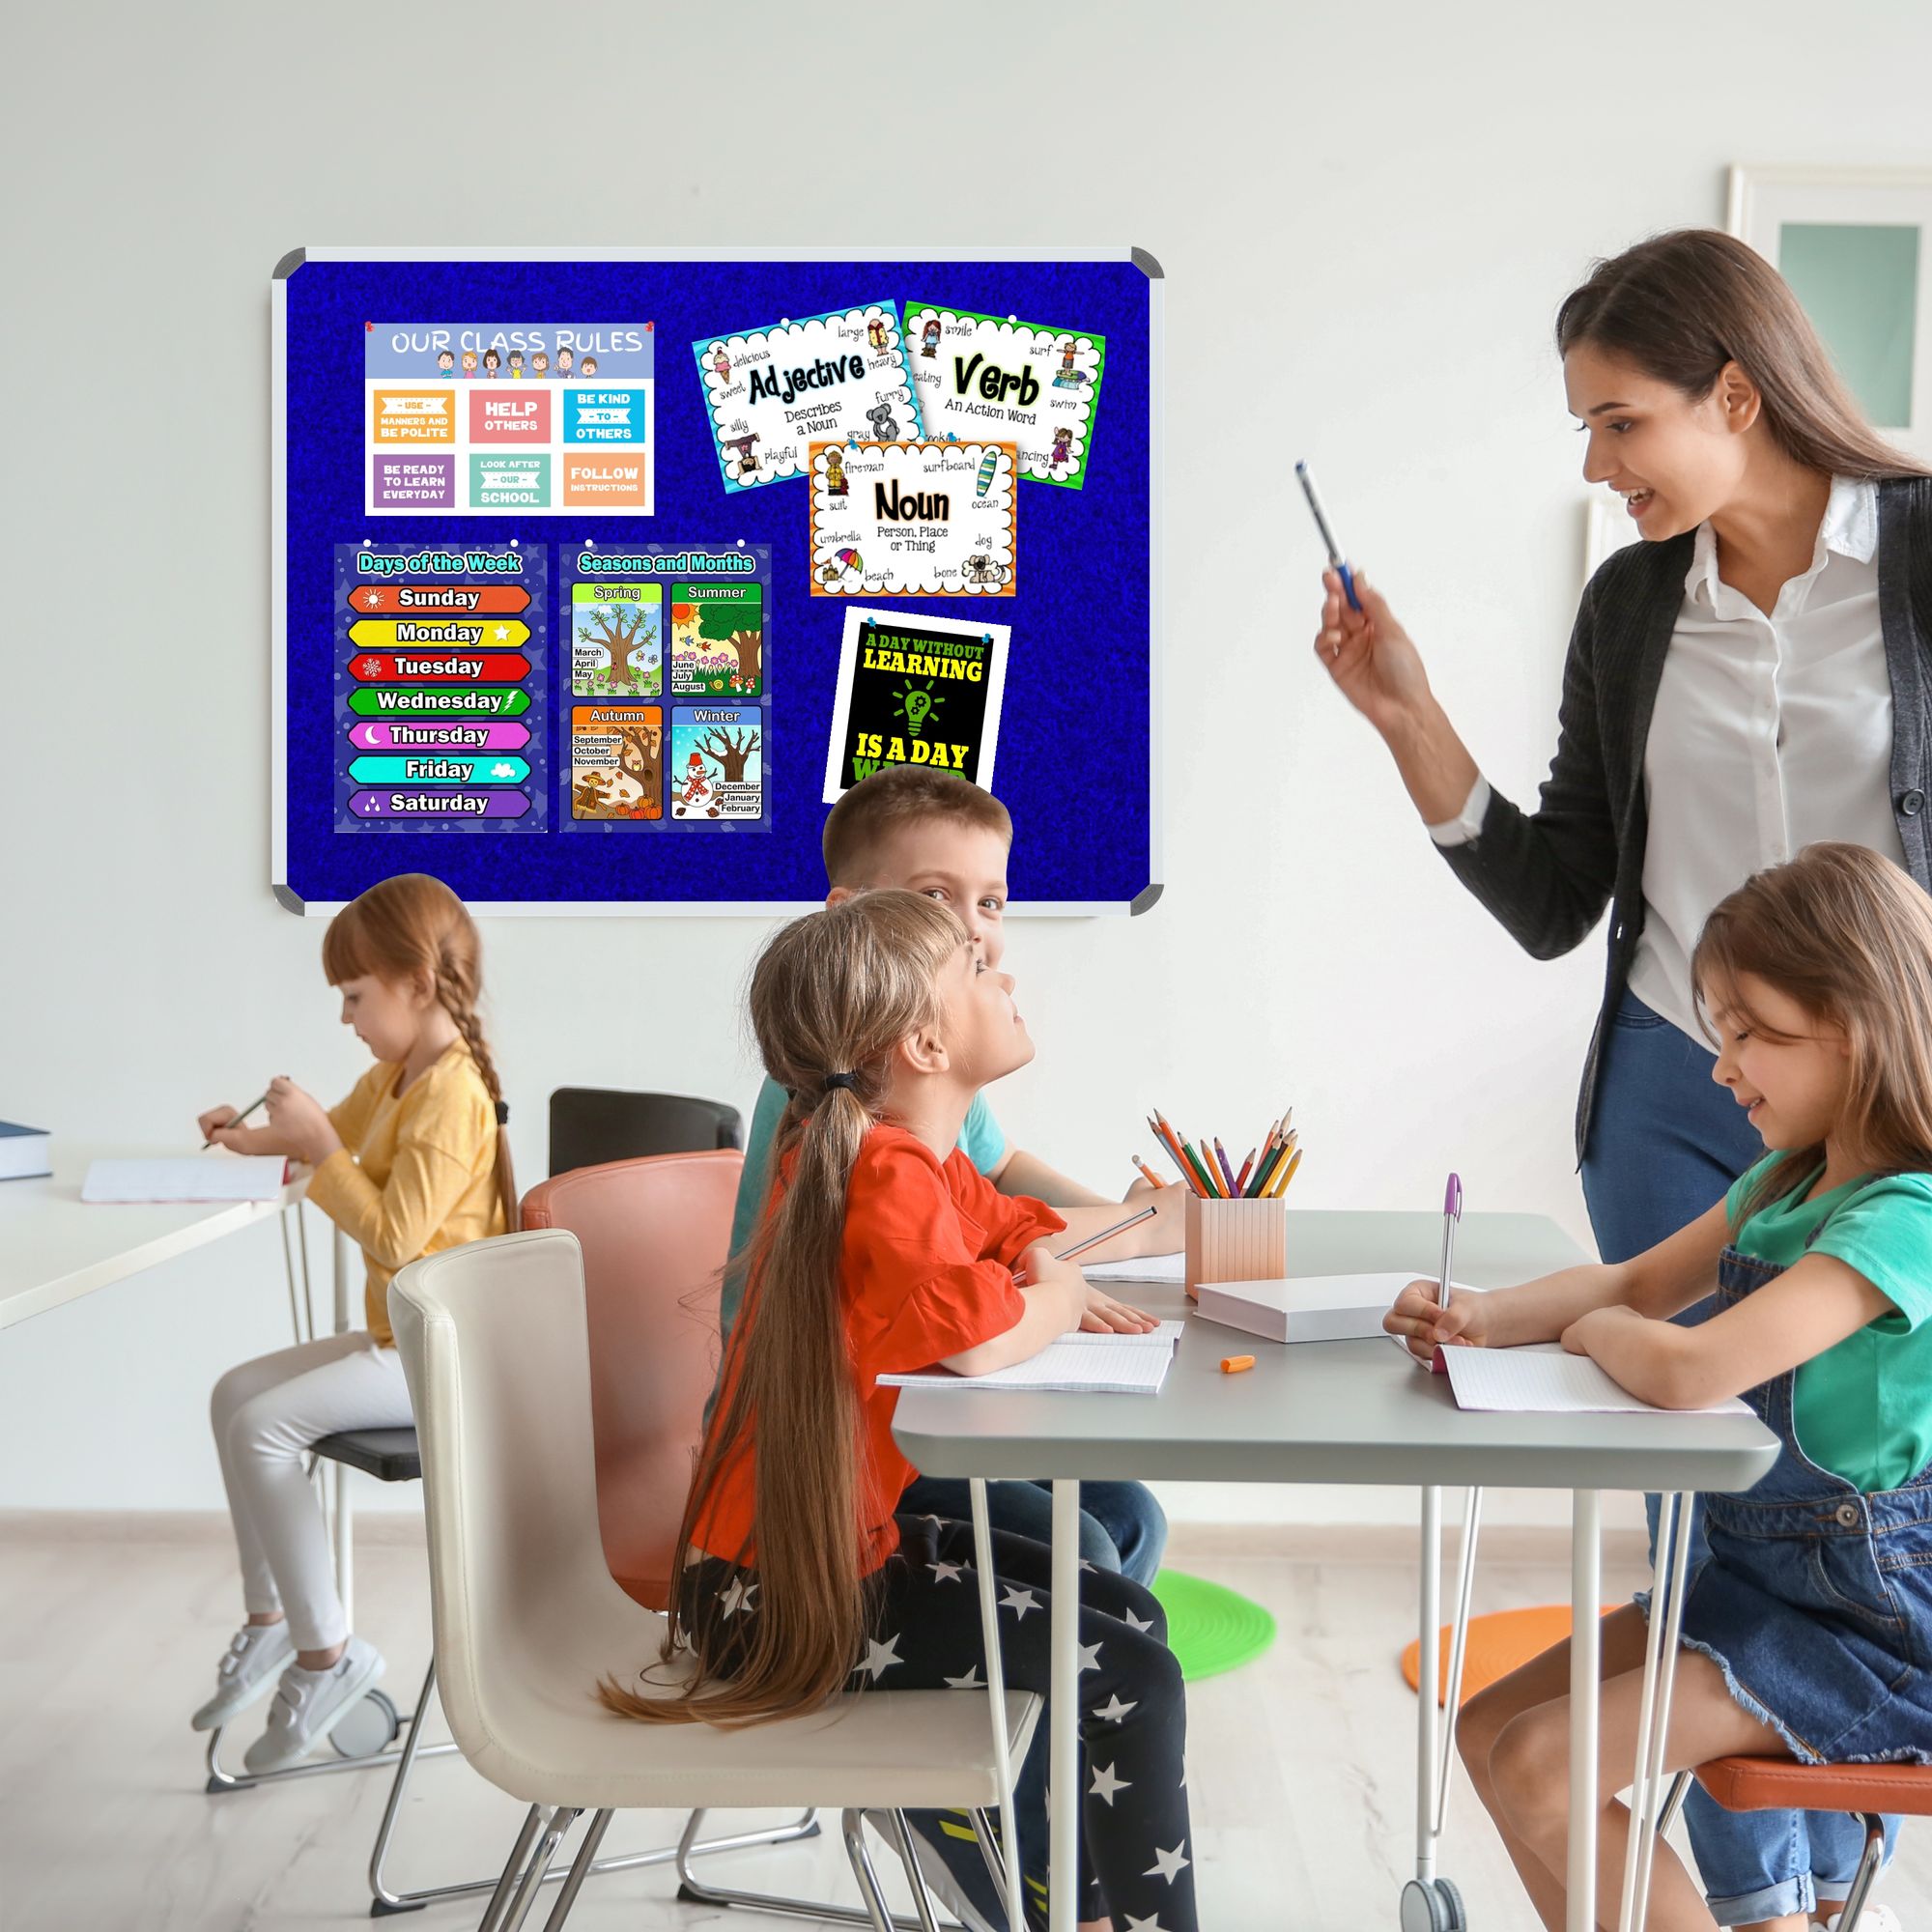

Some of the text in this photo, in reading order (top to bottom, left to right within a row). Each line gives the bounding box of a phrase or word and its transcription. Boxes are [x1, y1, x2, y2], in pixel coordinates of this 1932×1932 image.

[838, 326, 864, 341] large
[945, 324, 972, 336] smile
[391, 330, 642, 353] OUR CLASS RULES
[1029, 345, 1054, 356] surf
[732, 349, 771, 368] delicious
[867, 354, 897, 371] heavy
[749, 355, 866, 405] Adjective
[913, 370, 942, 389] eating
[954, 353, 1039, 406] Verb
[720, 383, 747, 400] sweet
[875, 388, 905, 404] furry
[577, 393, 631, 404] BE KIND
[1049, 398, 1077, 411] swim
[485, 402, 538, 416] HELP
[784, 401, 842, 423] Describes
[944, 398, 1037, 425] An Action Word
[596, 412, 611, 421] TO
[484, 420, 537, 431] OTHERS
[730, 418, 749, 434] silly
[796, 417, 838, 436] a Noun
[381, 428, 447, 438] BE POLITE
[576, 428, 632, 439] OTHERS
[847, 430, 870, 442] gray
[764, 446, 798, 465] playful
[1016, 450, 1049, 469] ancing
[384, 465, 445, 474] BE READY
[844, 461, 885, 474] fireman
[923, 458, 976, 472] surfboard
[500, 475, 519, 484] OUR
[571, 467, 638, 480] FOLLOW
[384, 477, 445, 487] TO LEARN
[383, 490, 445, 499] EVERYDAY
[480, 492, 539, 503] SCHOOL
[875, 479, 950, 521] Noun
[829, 498, 848, 511] suit
[971, 498, 999, 509] ocean
[820, 530, 863, 544] umbrella
[877, 526, 949, 538] Person, Place
[890, 540, 936, 554] or Thing
[975, 534, 993, 550] dog
[358, 553, 521, 575] Days of the Week
[579, 554, 753, 573] Seasons and Months
[865, 567, 895, 582] beach
[934, 566, 957, 578] bone
[398, 588, 480, 610] Sunday
[594, 586, 640, 601] Spring
[688, 586, 746, 599] Summer
[396, 623, 483, 644] Monday
[574, 648, 602, 657] March
[866, 633, 984, 660] A DAY WITHOUT
[394, 657, 483, 678] Tuesday
[574, 659, 596, 669] April
[672, 661, 695, 669] June
[863, 648, 983, 682] LEARNING
[574, 670, 593, 679] May
[672, 672, 692, 682] July
[672, 683, 704, 693] August
[377, 692, 502, 713] Wednesday
[590, 709, 644, 722] Autumn
[694, 709, 740, 722] Winter
[390, 725, 489, 747] Thursday
[574, 735, 622, 746] September
[574, 747, 610, 755] October
[856, 732, 969, 769] IS A DAY
[574, 757, 619, 766] November
[406, 759, 473, 781] Friday
[715, 781, 760, 790] December
[390, 793, 489, 814] Saturday
[724, 793, 760, 803] January
[721, 804, 760, 814] February
